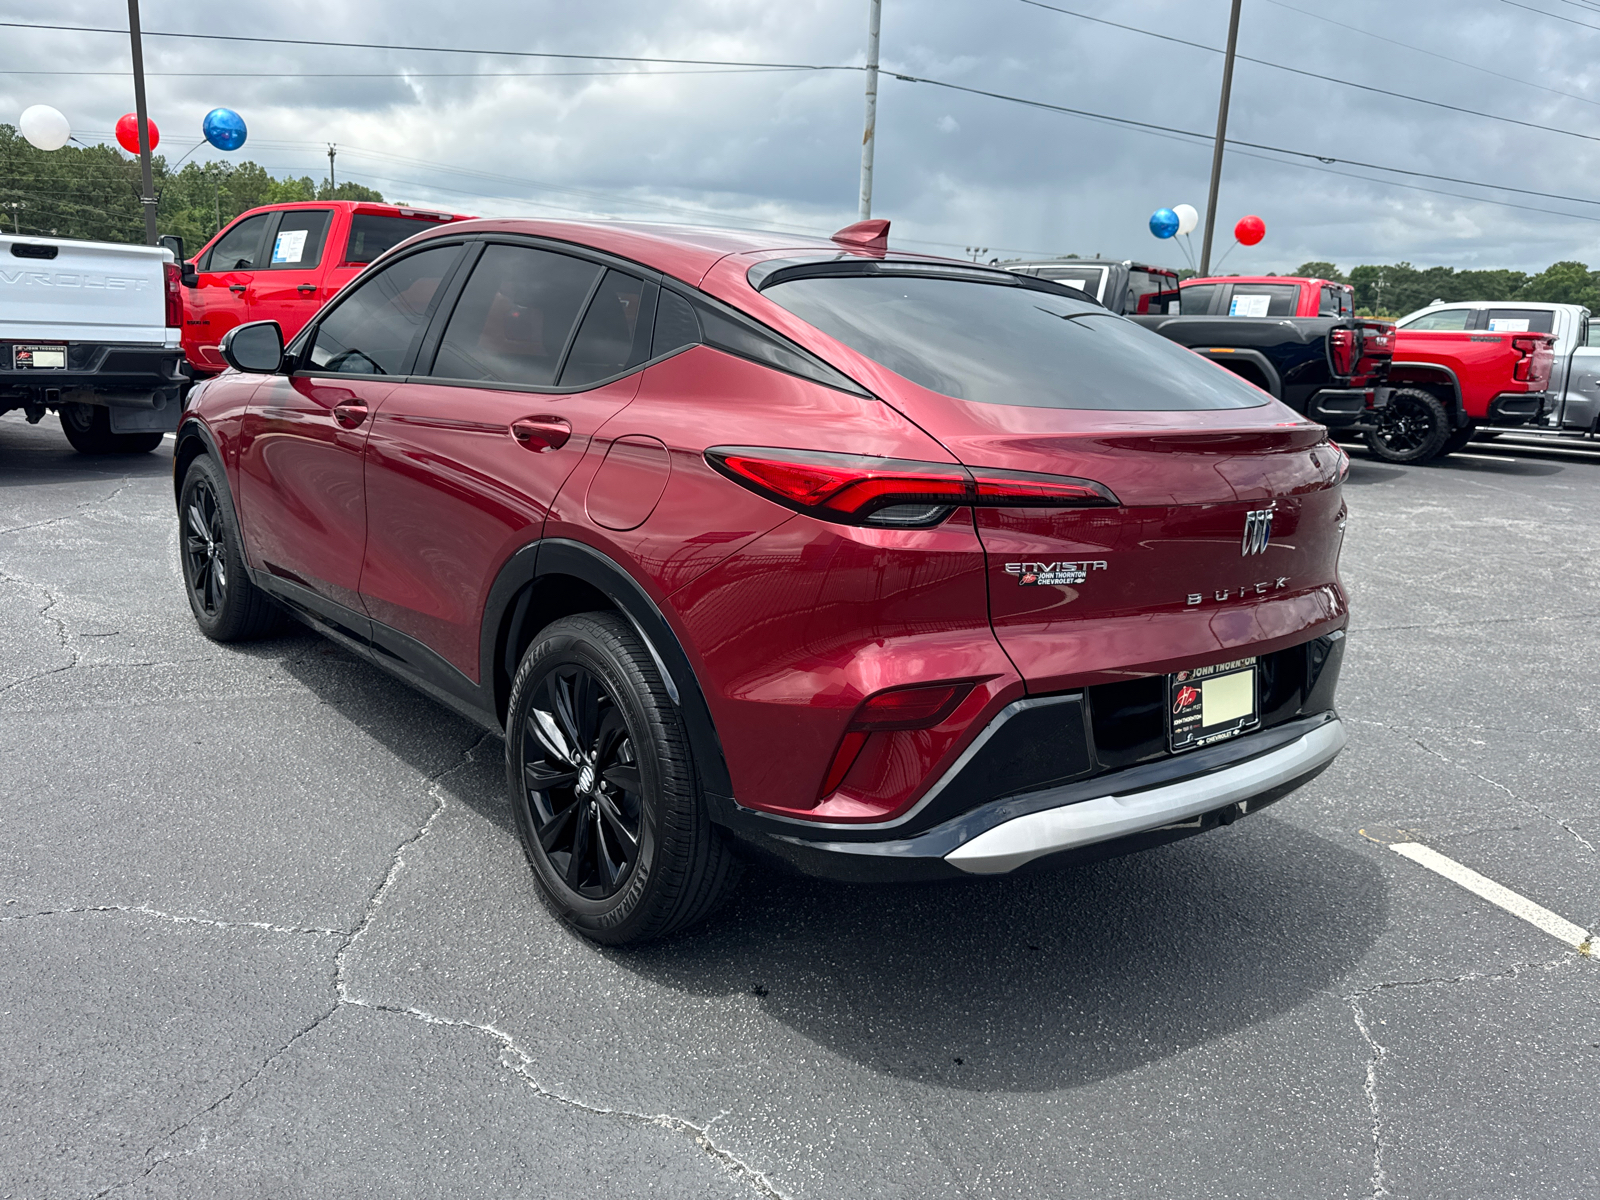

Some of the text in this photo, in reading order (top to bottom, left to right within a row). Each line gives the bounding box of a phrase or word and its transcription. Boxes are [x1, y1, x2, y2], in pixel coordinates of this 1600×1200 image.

[1005, 561, 1107, 572] ENVISTA
[1187, 577, 1291, 606] BUICK
[1192, 665, 1214, 677] JOHN
[509, 639, 553, 717] GOODYEAR
[1206, 731, 1232, 744] CHEVROLET
